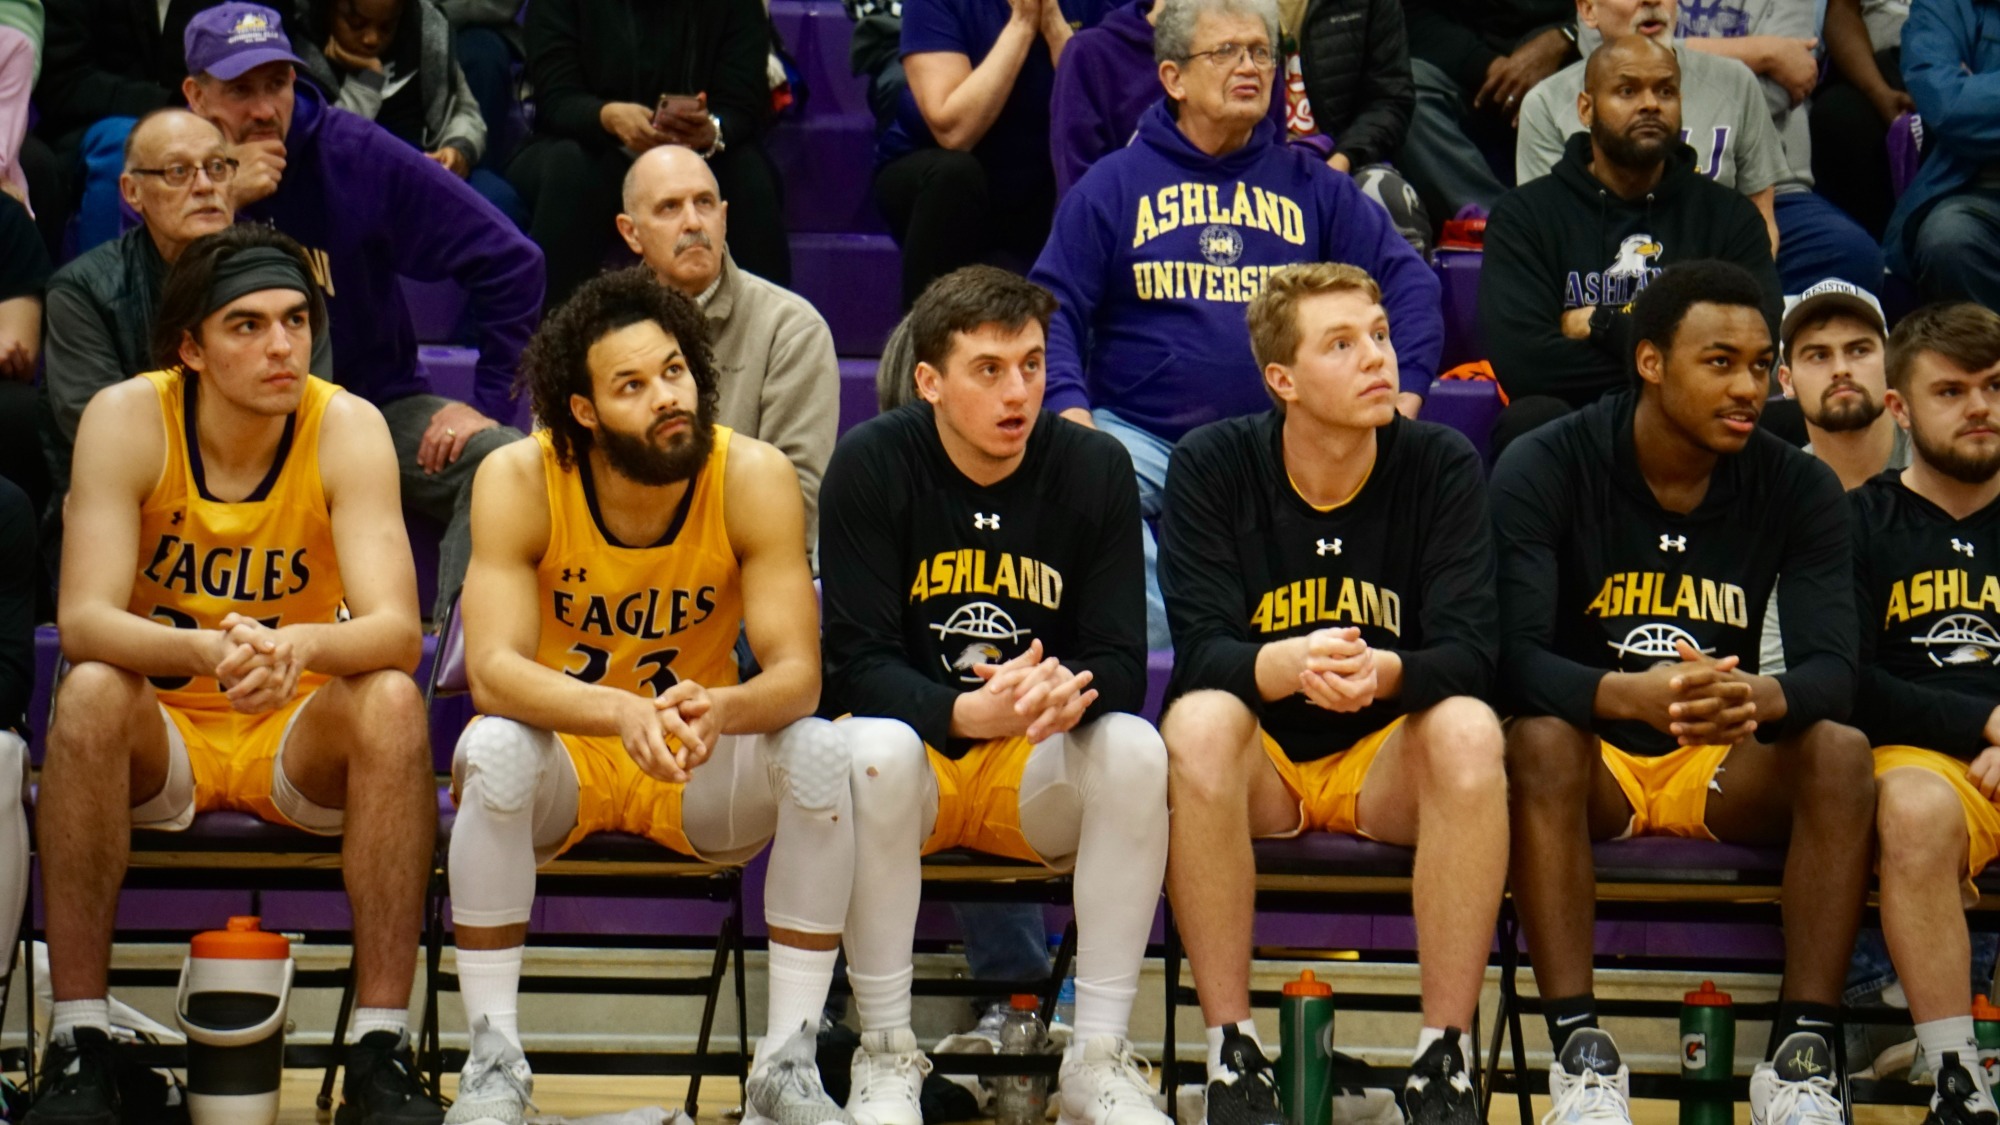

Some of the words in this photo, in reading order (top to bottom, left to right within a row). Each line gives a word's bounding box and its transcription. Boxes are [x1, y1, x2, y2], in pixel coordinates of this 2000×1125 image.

[1133, 181, 1306, 249] ASHLAND
[1133, 261, 1297, 302] UNIVERSI
[1564, 267, 1662, 308] ASHLA
[1804, 281, 1854, 298] RESISTOL
[144, 533, 310, 601] EAGLES
[909, 548, 1063, 610] ASHLAND
[553, 585, 717, 640] EAGLES
[1250, 576, 1401, 638] ASHLAND
[1585, 572, 1749, 629] ASHLAND
